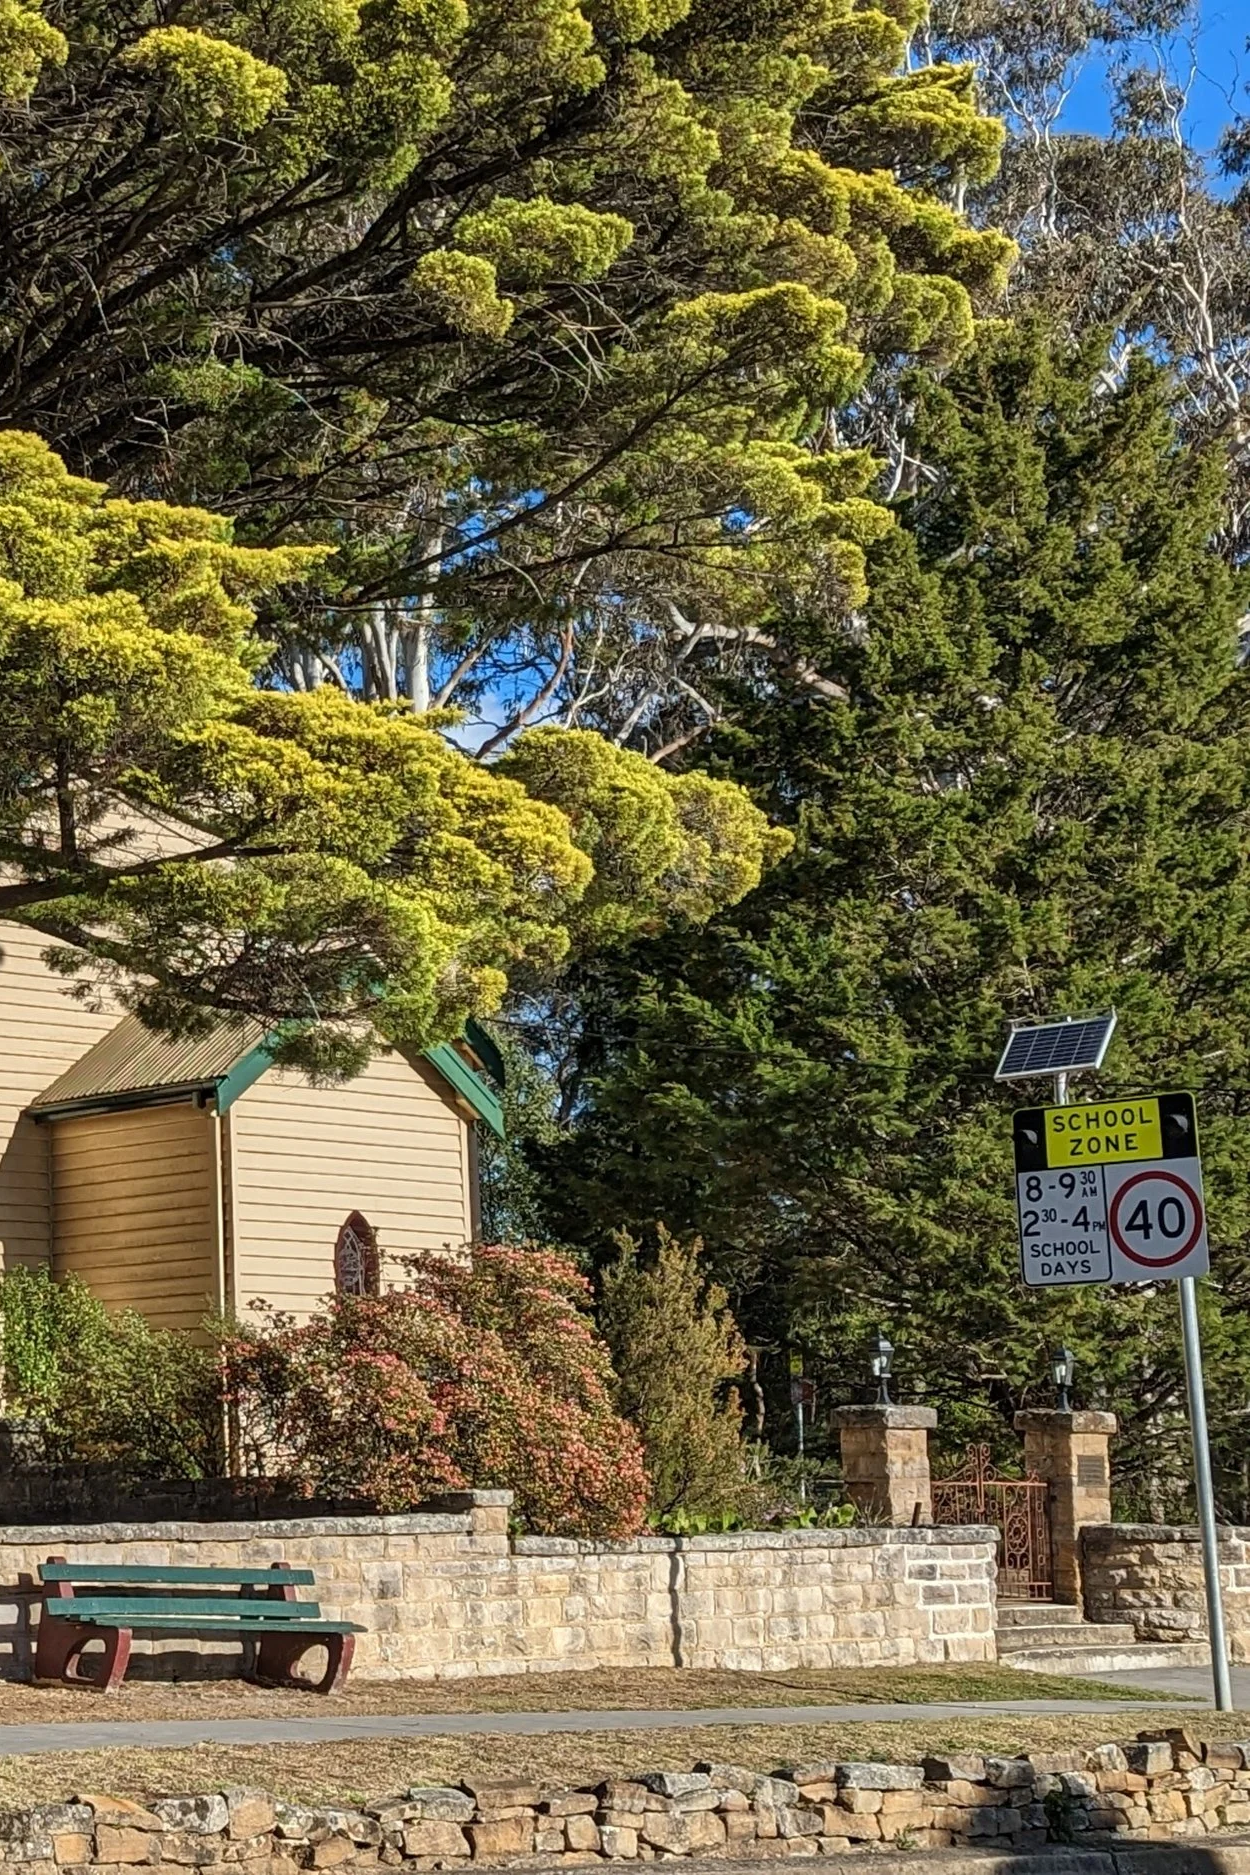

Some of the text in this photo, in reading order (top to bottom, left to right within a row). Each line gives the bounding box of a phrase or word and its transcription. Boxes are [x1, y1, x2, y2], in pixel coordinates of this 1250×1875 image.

[1052, 1106, 1153, 1133] SCHOOL
[1069, 1133, 1139, 1157] ZONE
[1124, 1196, 1187, 1240] 40
[1030, 1239, 1102, 1259] SCHOOL
[1040, 1259, 1093, 1278] DAYS
